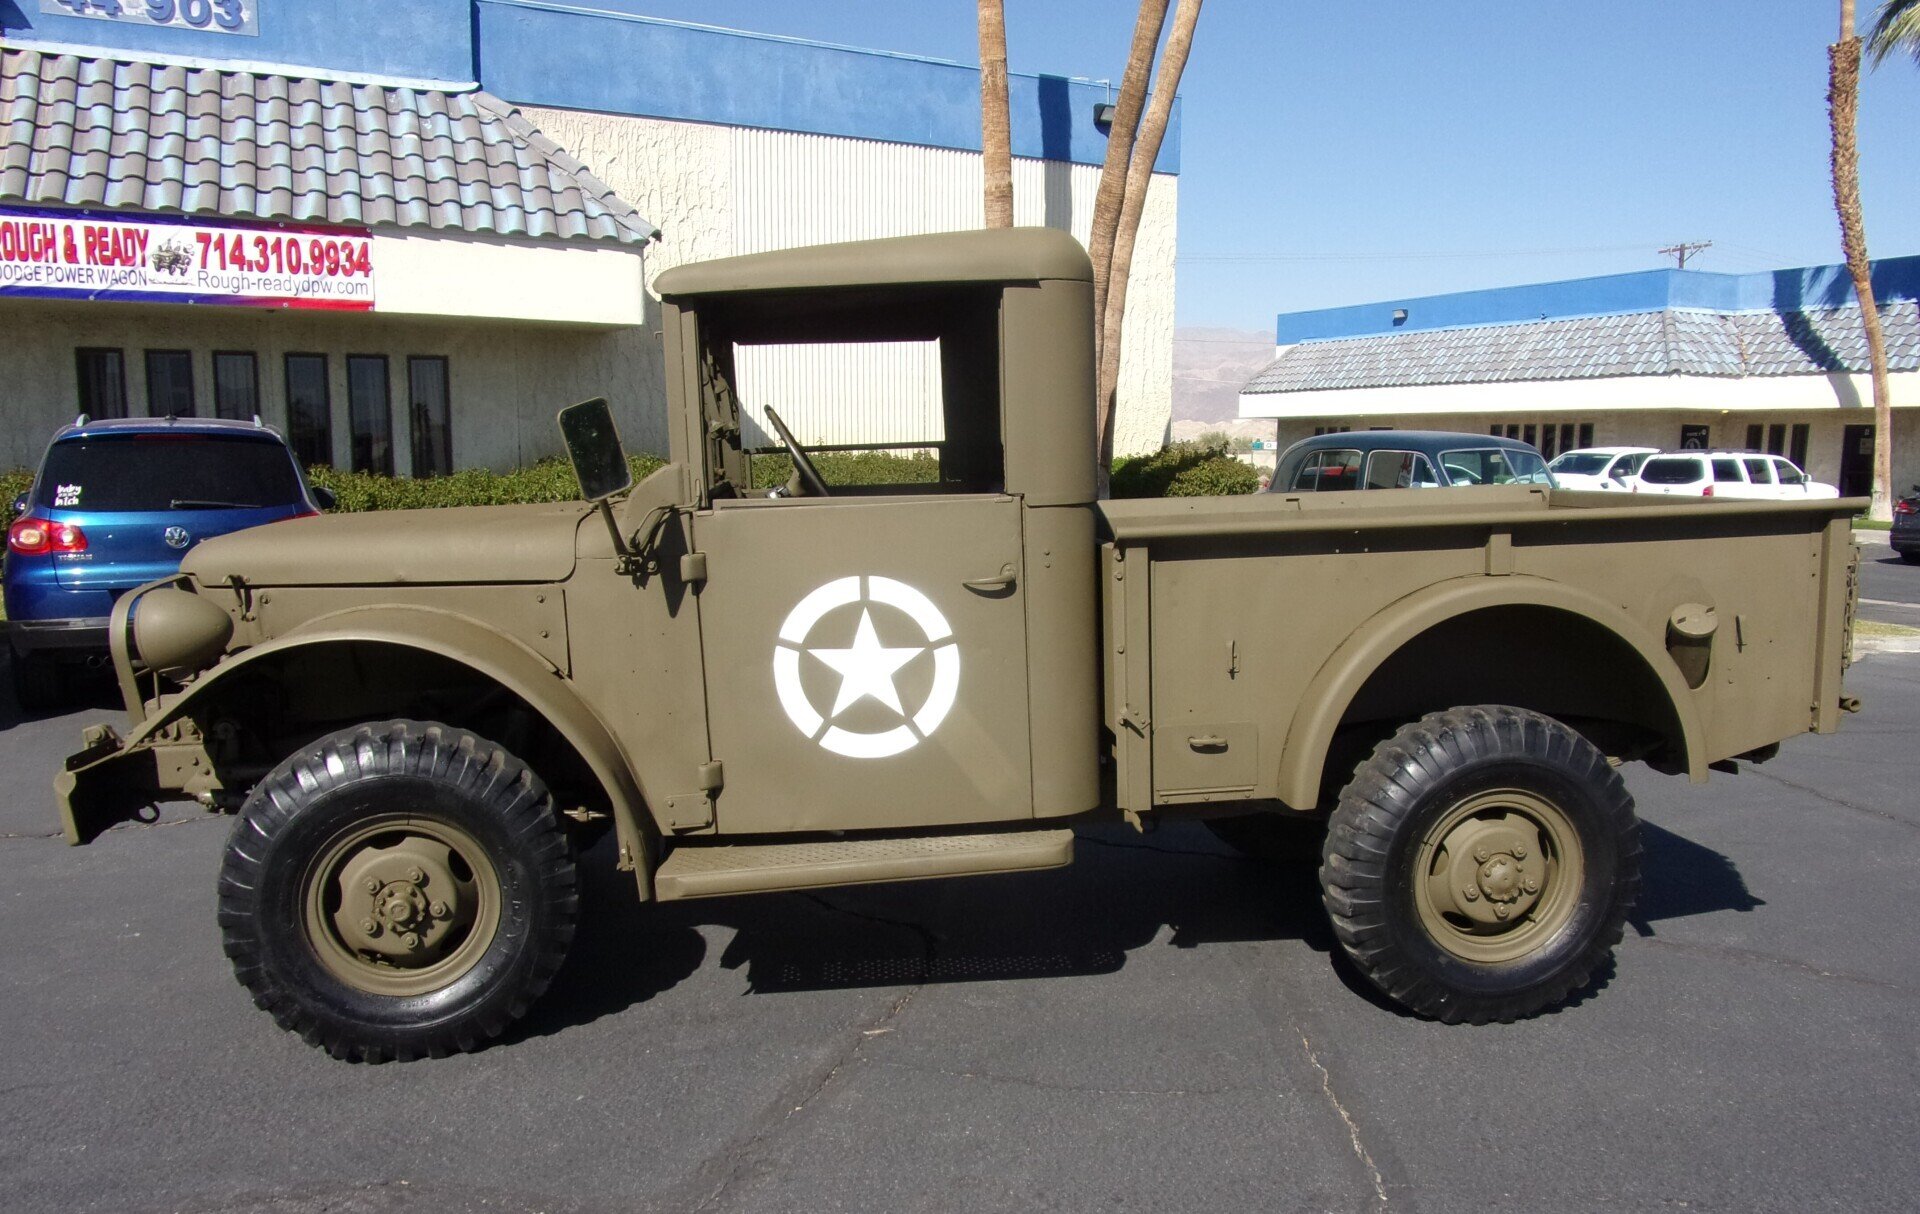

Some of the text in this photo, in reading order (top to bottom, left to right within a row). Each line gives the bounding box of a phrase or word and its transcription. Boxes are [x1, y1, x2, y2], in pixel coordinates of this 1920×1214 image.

[0, 221, 149, 267] OUGH & READY
[195, 232, 371, 277] 714.310.9934
[46, 266, 94, 284] POWER
[98, 269, 147, 286] WAGON
[197, 270, 368, 296] Rough-readydpw.com
